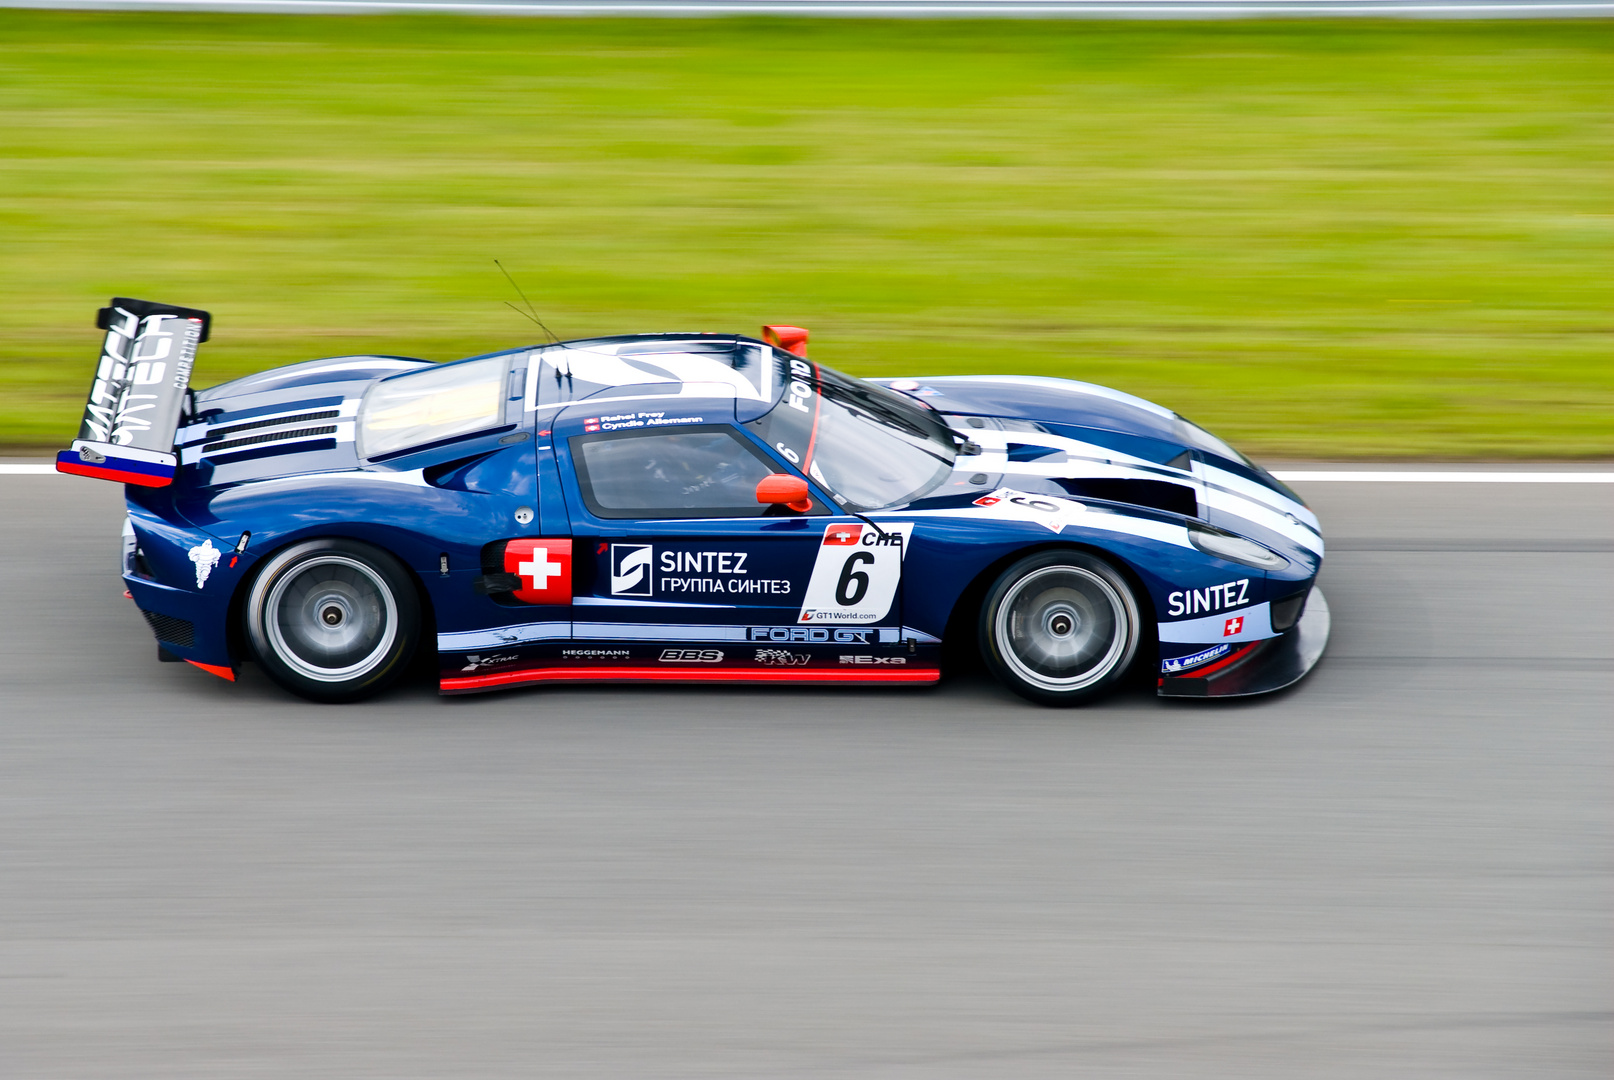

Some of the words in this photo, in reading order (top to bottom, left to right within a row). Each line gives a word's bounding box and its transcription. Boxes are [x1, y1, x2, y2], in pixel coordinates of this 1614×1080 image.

[173, 321, 203, 390] COMPETITION
[600, 413, 636, 423] Rahel
[637, 411, 666, 419] Frey
[601, 420, 645, 431] Cyndie
[646, 417, 704, 426] Allemann
[776, 442, 800, 464] 6
[1009, 496, 1061, 513] 6
[862, 532, 902, 547] CHE
[660, 550, 748, 574] SINTEZ
[660, 577, 725, 594] ГРУППА
[728, 578, 791, 594] СИНТЕЗ
[834, 551, 875, 607] 6
[1167, 578, 1250, 617] SINTEZ
[750, 627, 830, 642] FORD
[833, 628, 874, 642] GT
[657, 649, 725, 663] BBS
[764, 653, 811, 666] KW
[854, 655, 907, 664] Exa
[1183, 643, 1229, 666] MICHELIN
